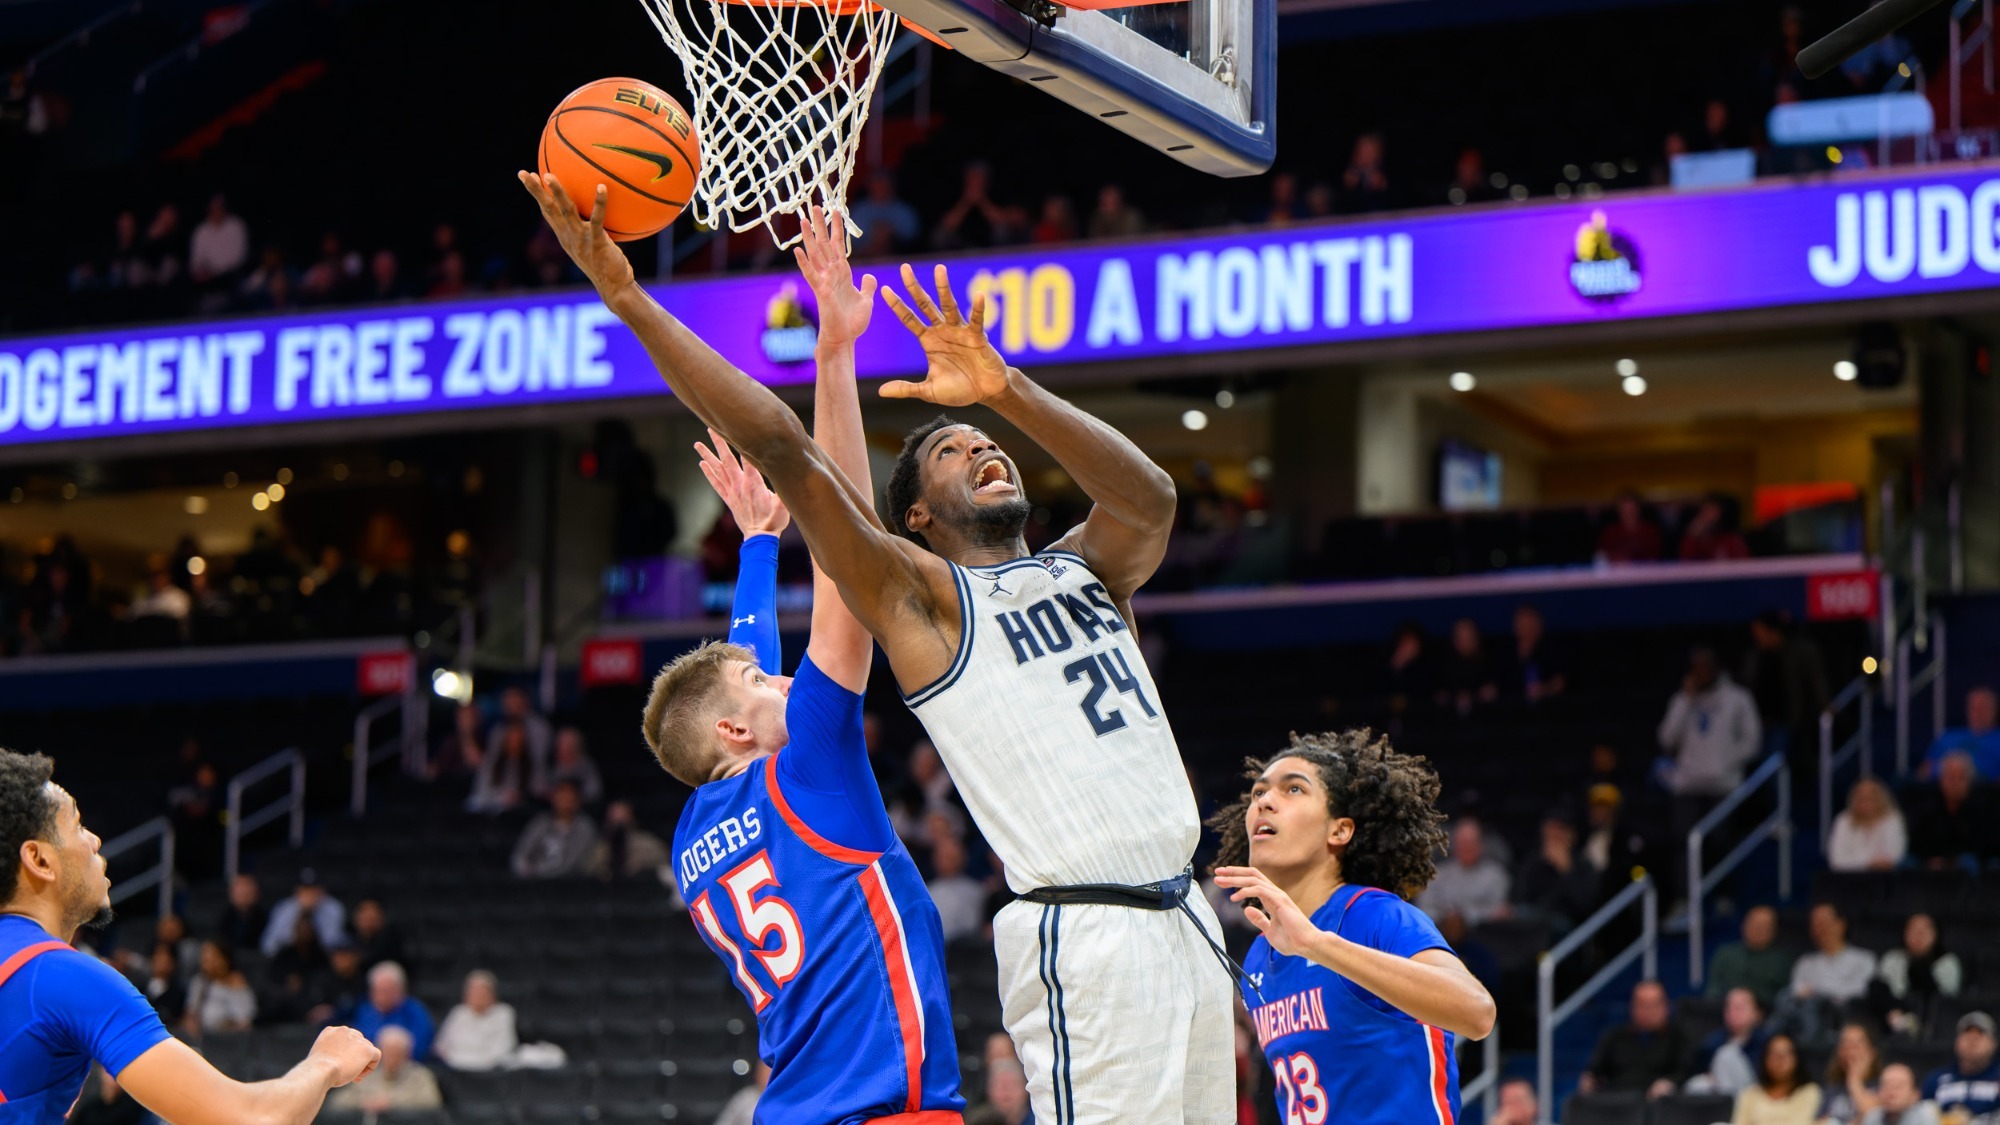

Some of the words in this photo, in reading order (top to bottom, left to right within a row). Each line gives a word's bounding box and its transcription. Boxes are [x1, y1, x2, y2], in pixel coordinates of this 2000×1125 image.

[615, 87, 689, 141] ELITE
[1808, 178, 2000, 287] JUDG
[1085, 257, 1143, 348] A
[1155, 232, 1413, 342] MONTH
[273, 316, 434, 411] FREE
[441, 303, 616, 399] ZONE
[1063, 647, 1159, 738] 24
[691, 848, 805, 1015] 15
